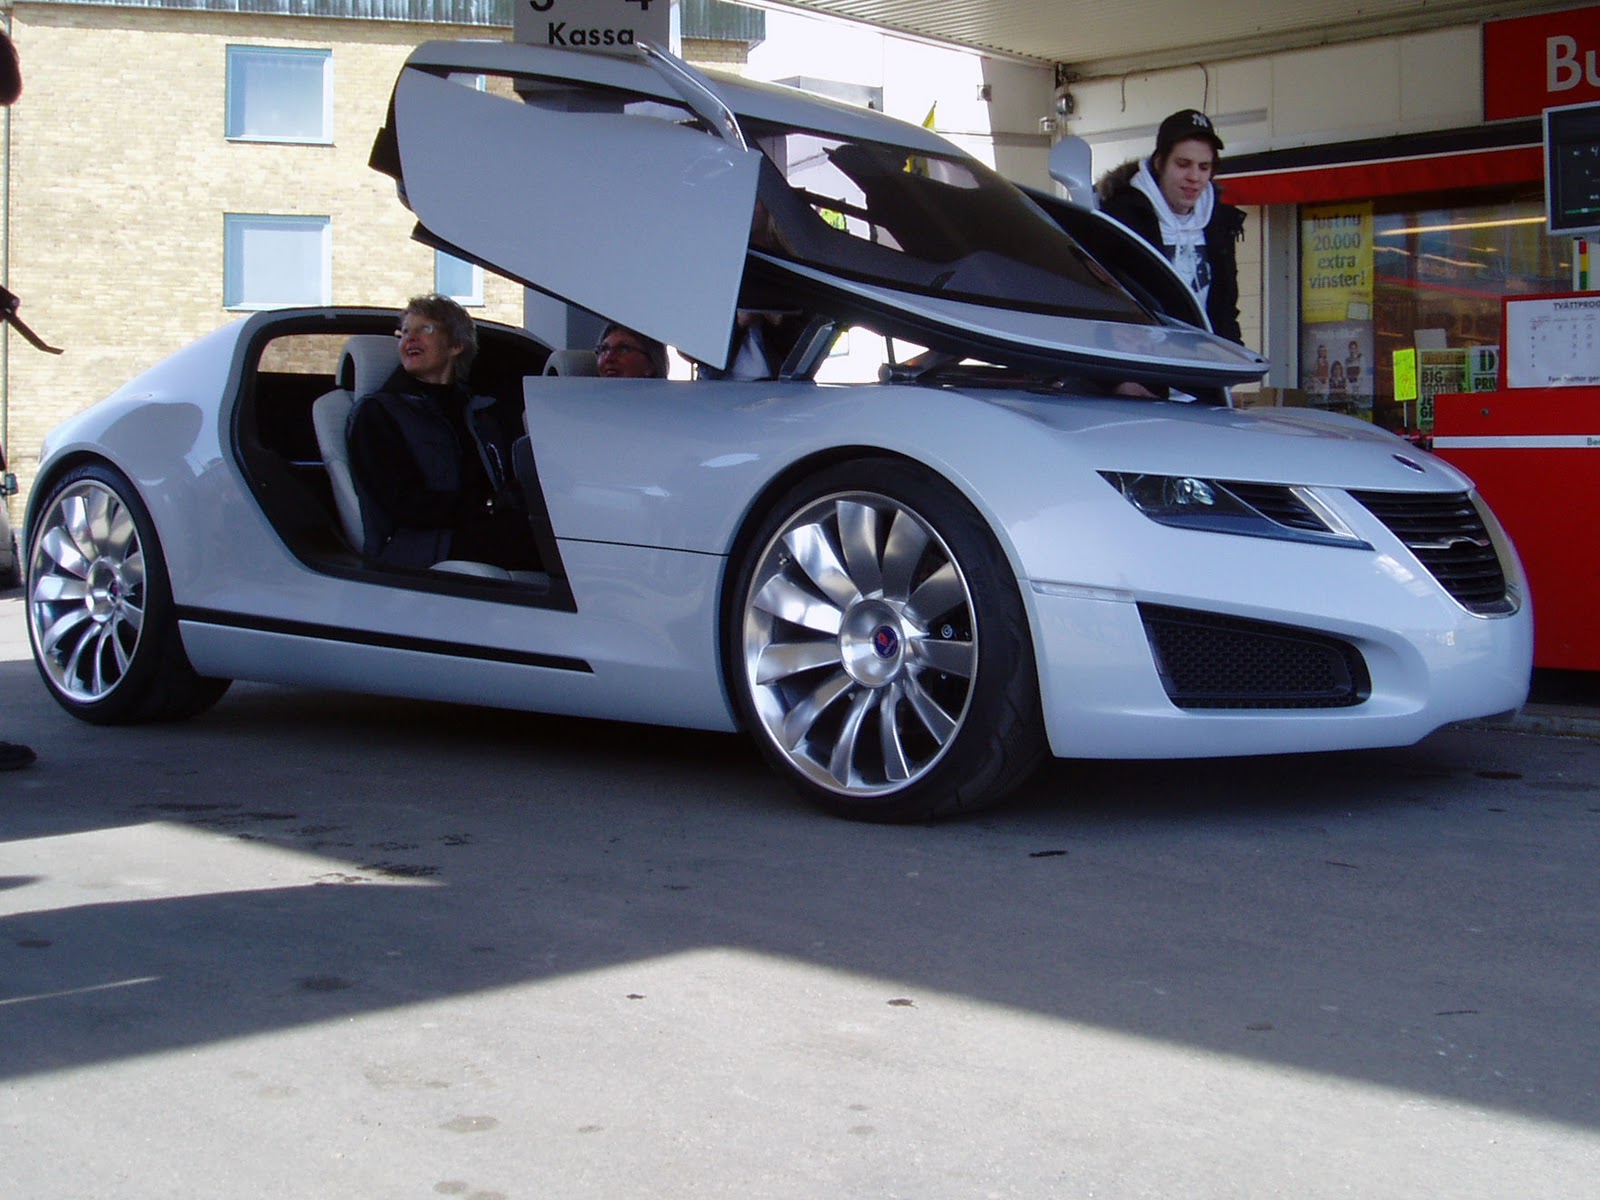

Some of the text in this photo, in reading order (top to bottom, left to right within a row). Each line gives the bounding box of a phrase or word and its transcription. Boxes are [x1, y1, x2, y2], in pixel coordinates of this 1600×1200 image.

[548, 22, 635, 46] Kassa
[1318, 254, 1356, 269] extra
[1309, 270, 1365, 288] vinster!
[1421, 371, 1443, 383] BIG
